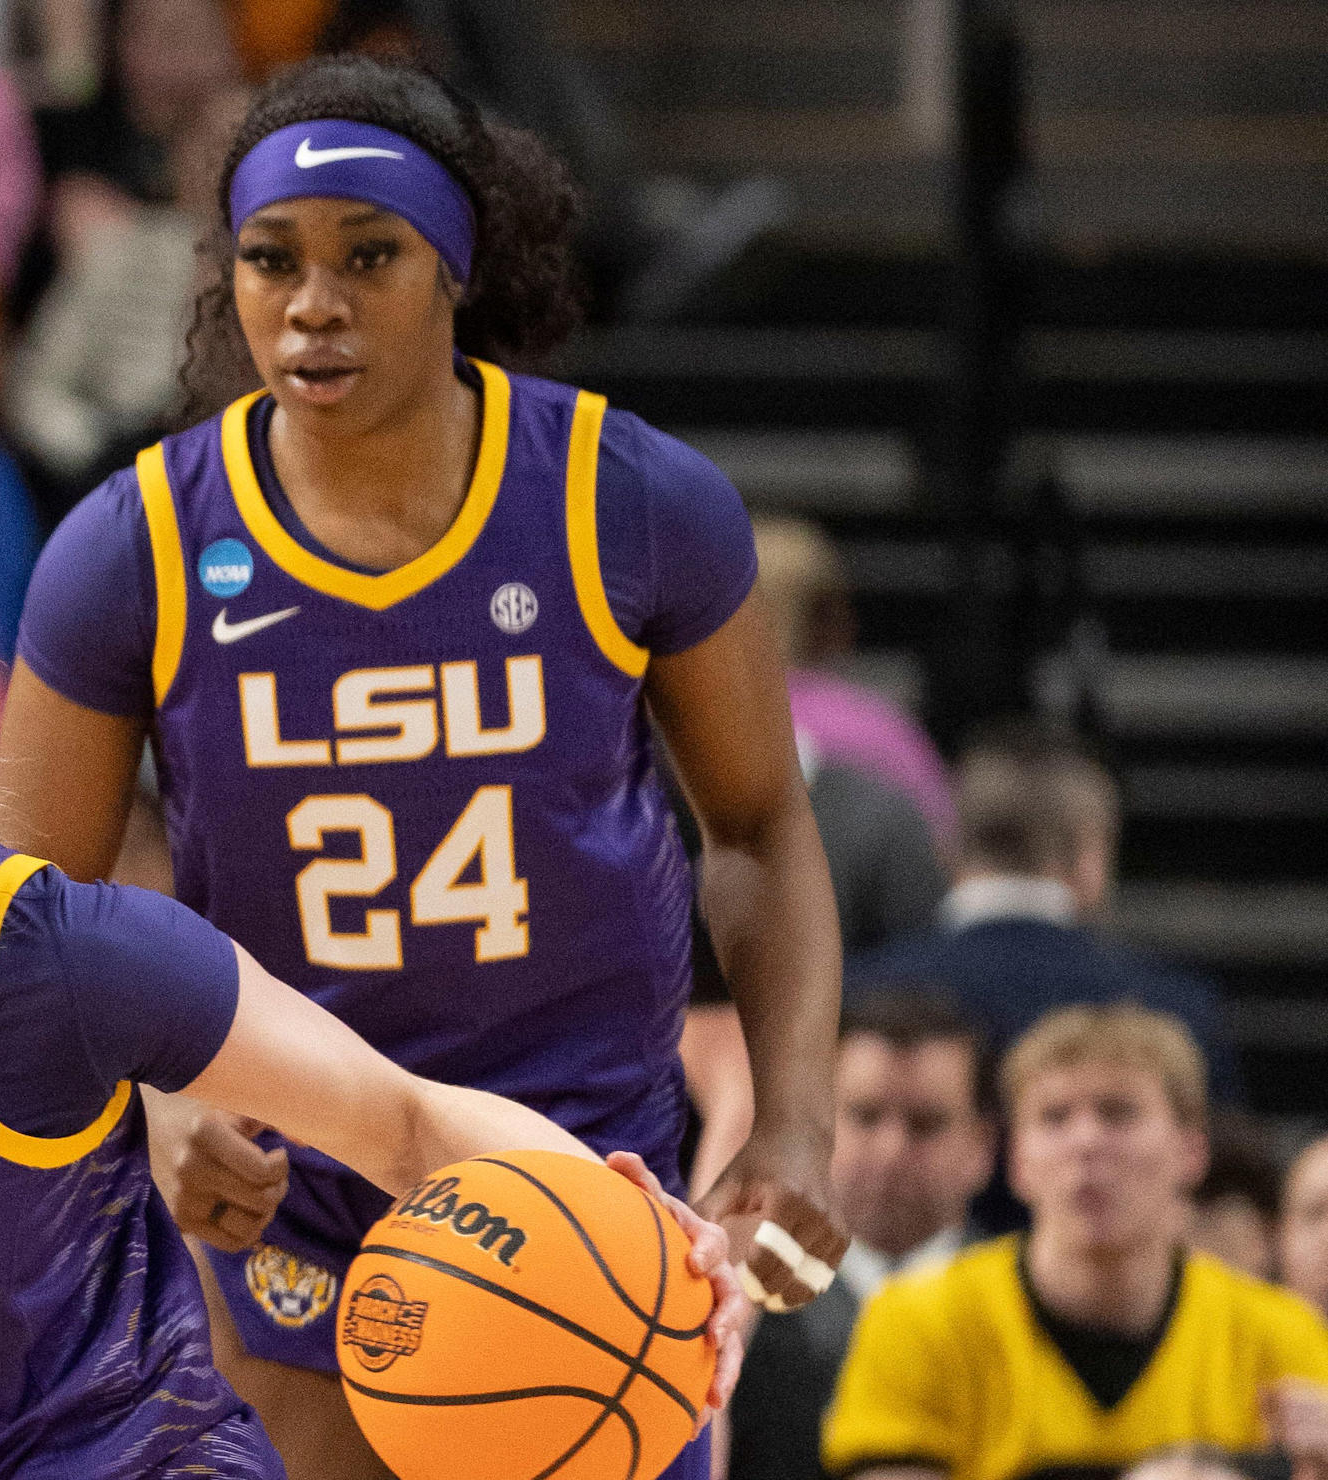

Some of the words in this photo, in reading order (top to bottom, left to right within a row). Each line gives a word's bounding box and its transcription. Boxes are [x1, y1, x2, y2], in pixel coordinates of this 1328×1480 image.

[494, 586, 534, 630] SEC
[238, 654, 547, 769] LSU
[285, 784, 530, 971] 24
[396, 1176, 527, 1267] ilson
